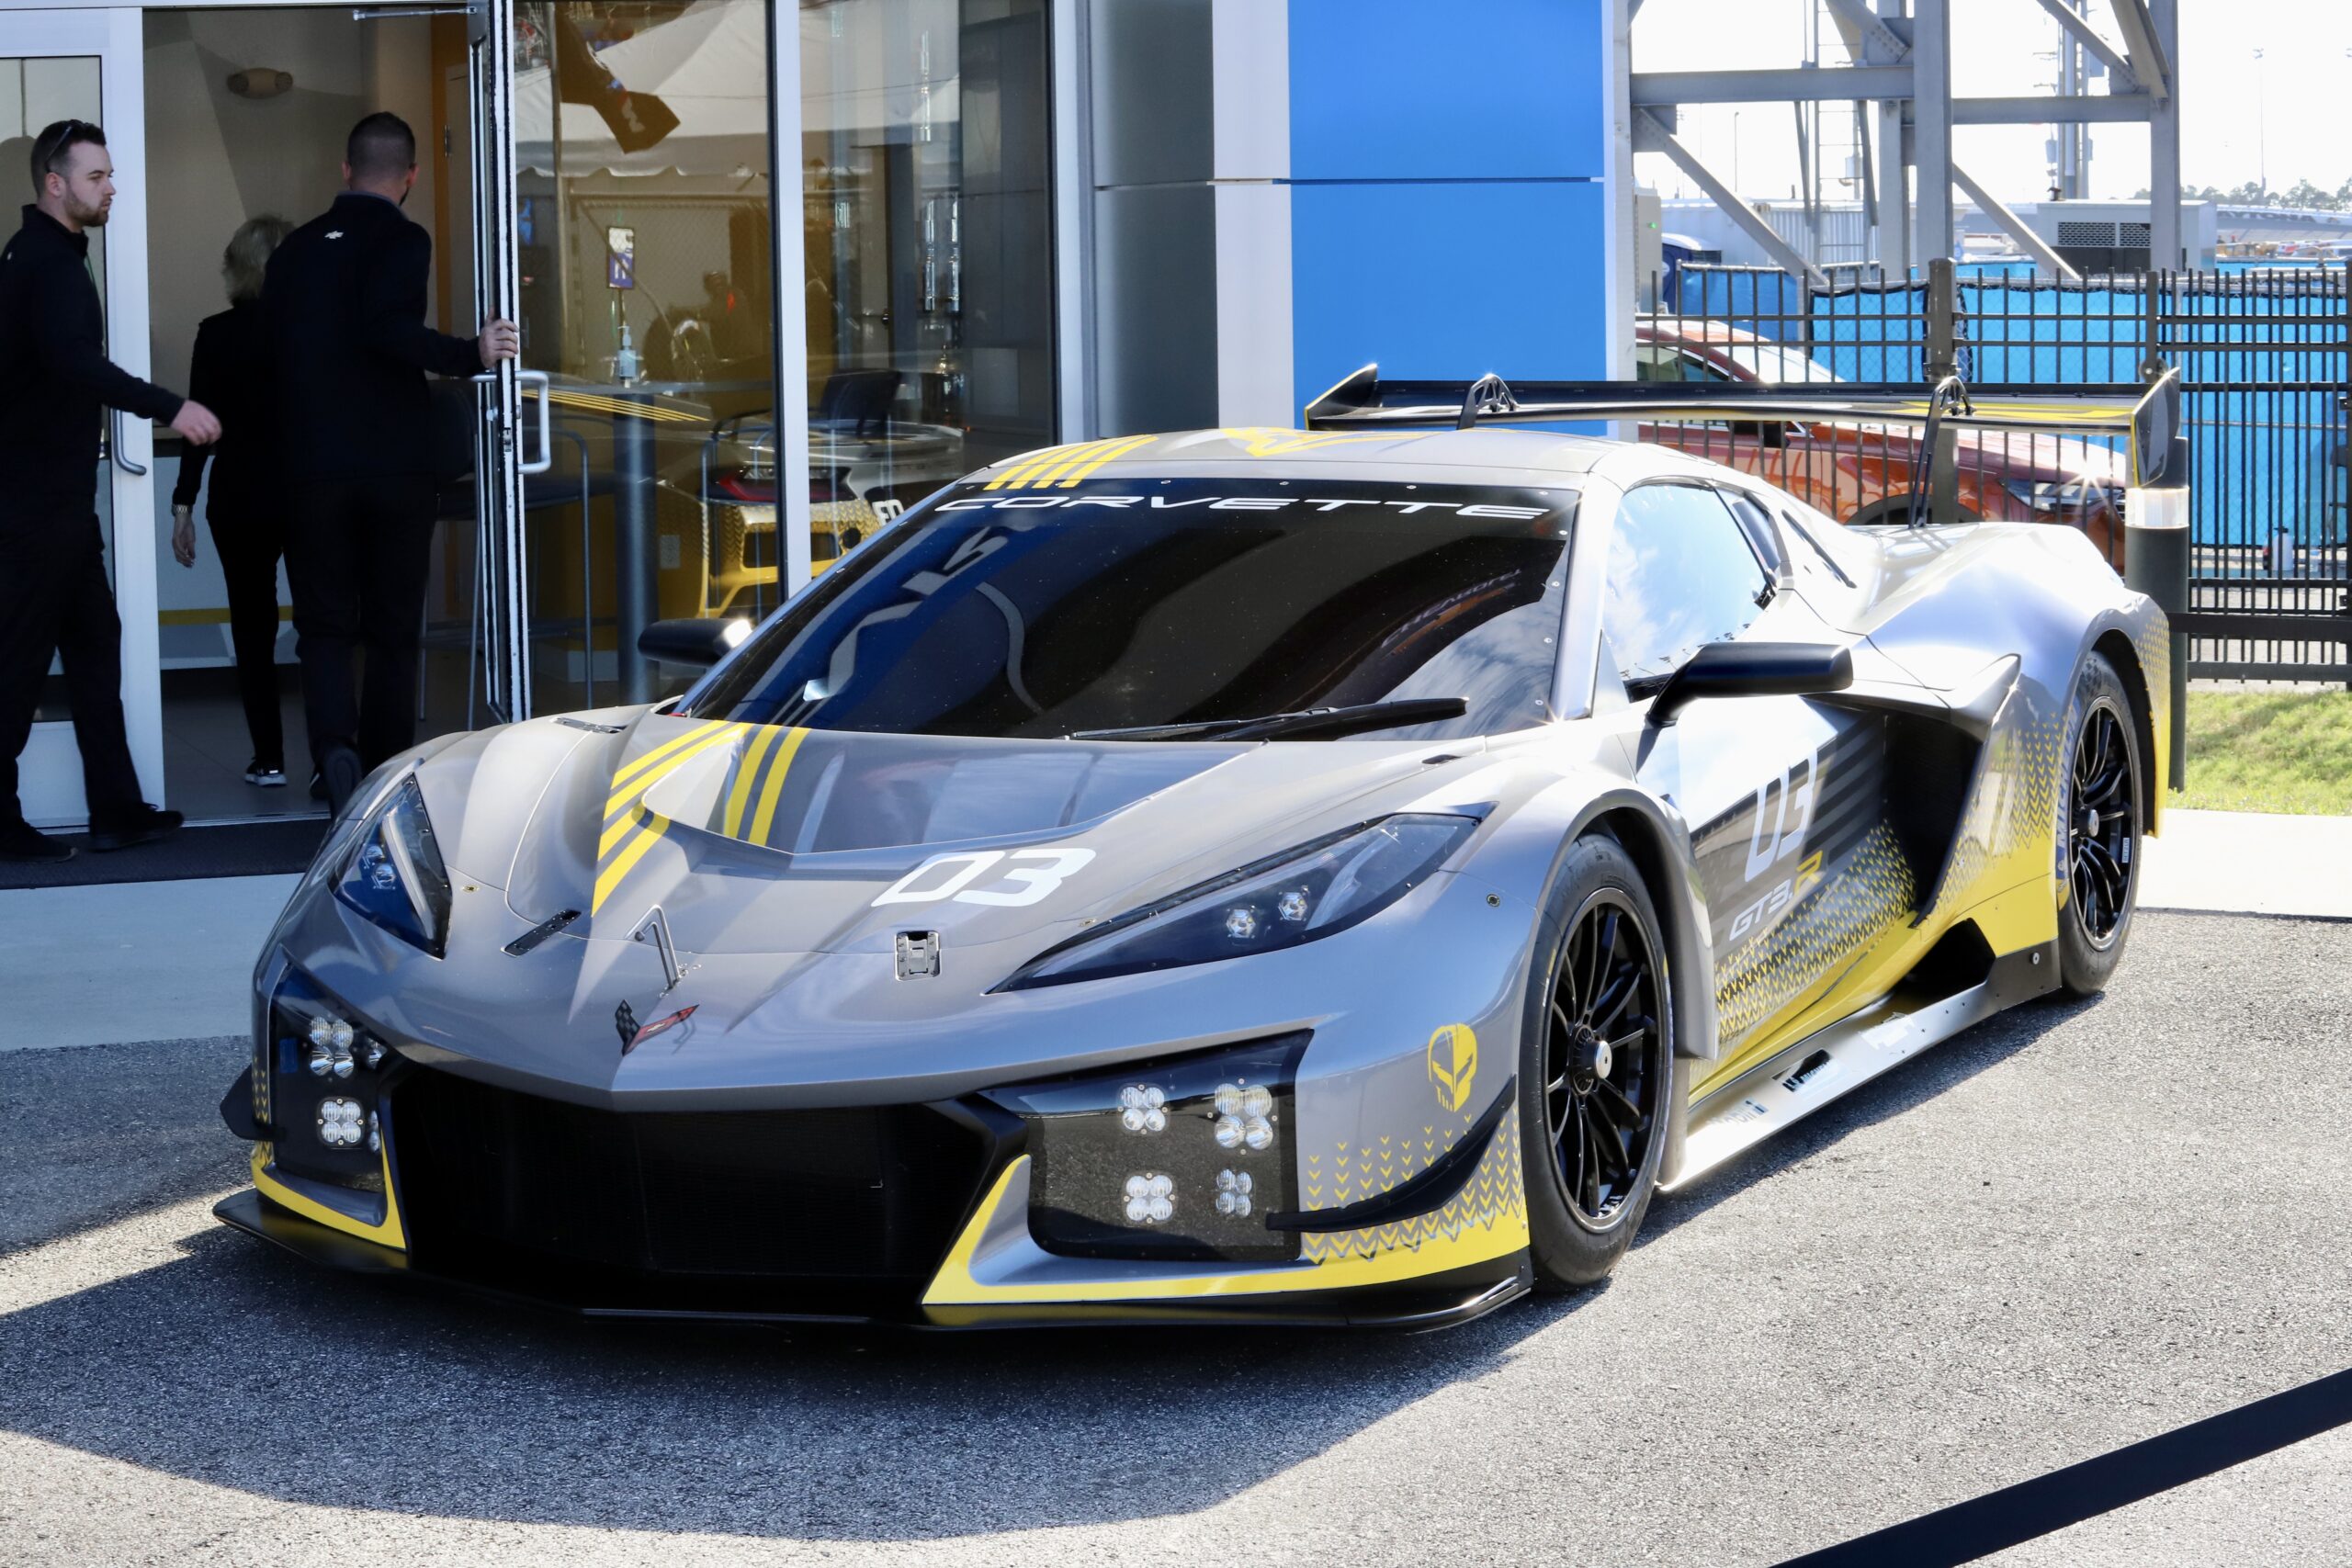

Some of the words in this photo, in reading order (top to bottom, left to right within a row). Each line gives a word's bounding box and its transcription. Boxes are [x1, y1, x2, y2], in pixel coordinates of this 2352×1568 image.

[934, 496, 1550, 519] CORVETTE
[1745, 739, 1818, 883] 03
[871, 848, 1096, 907] 03
